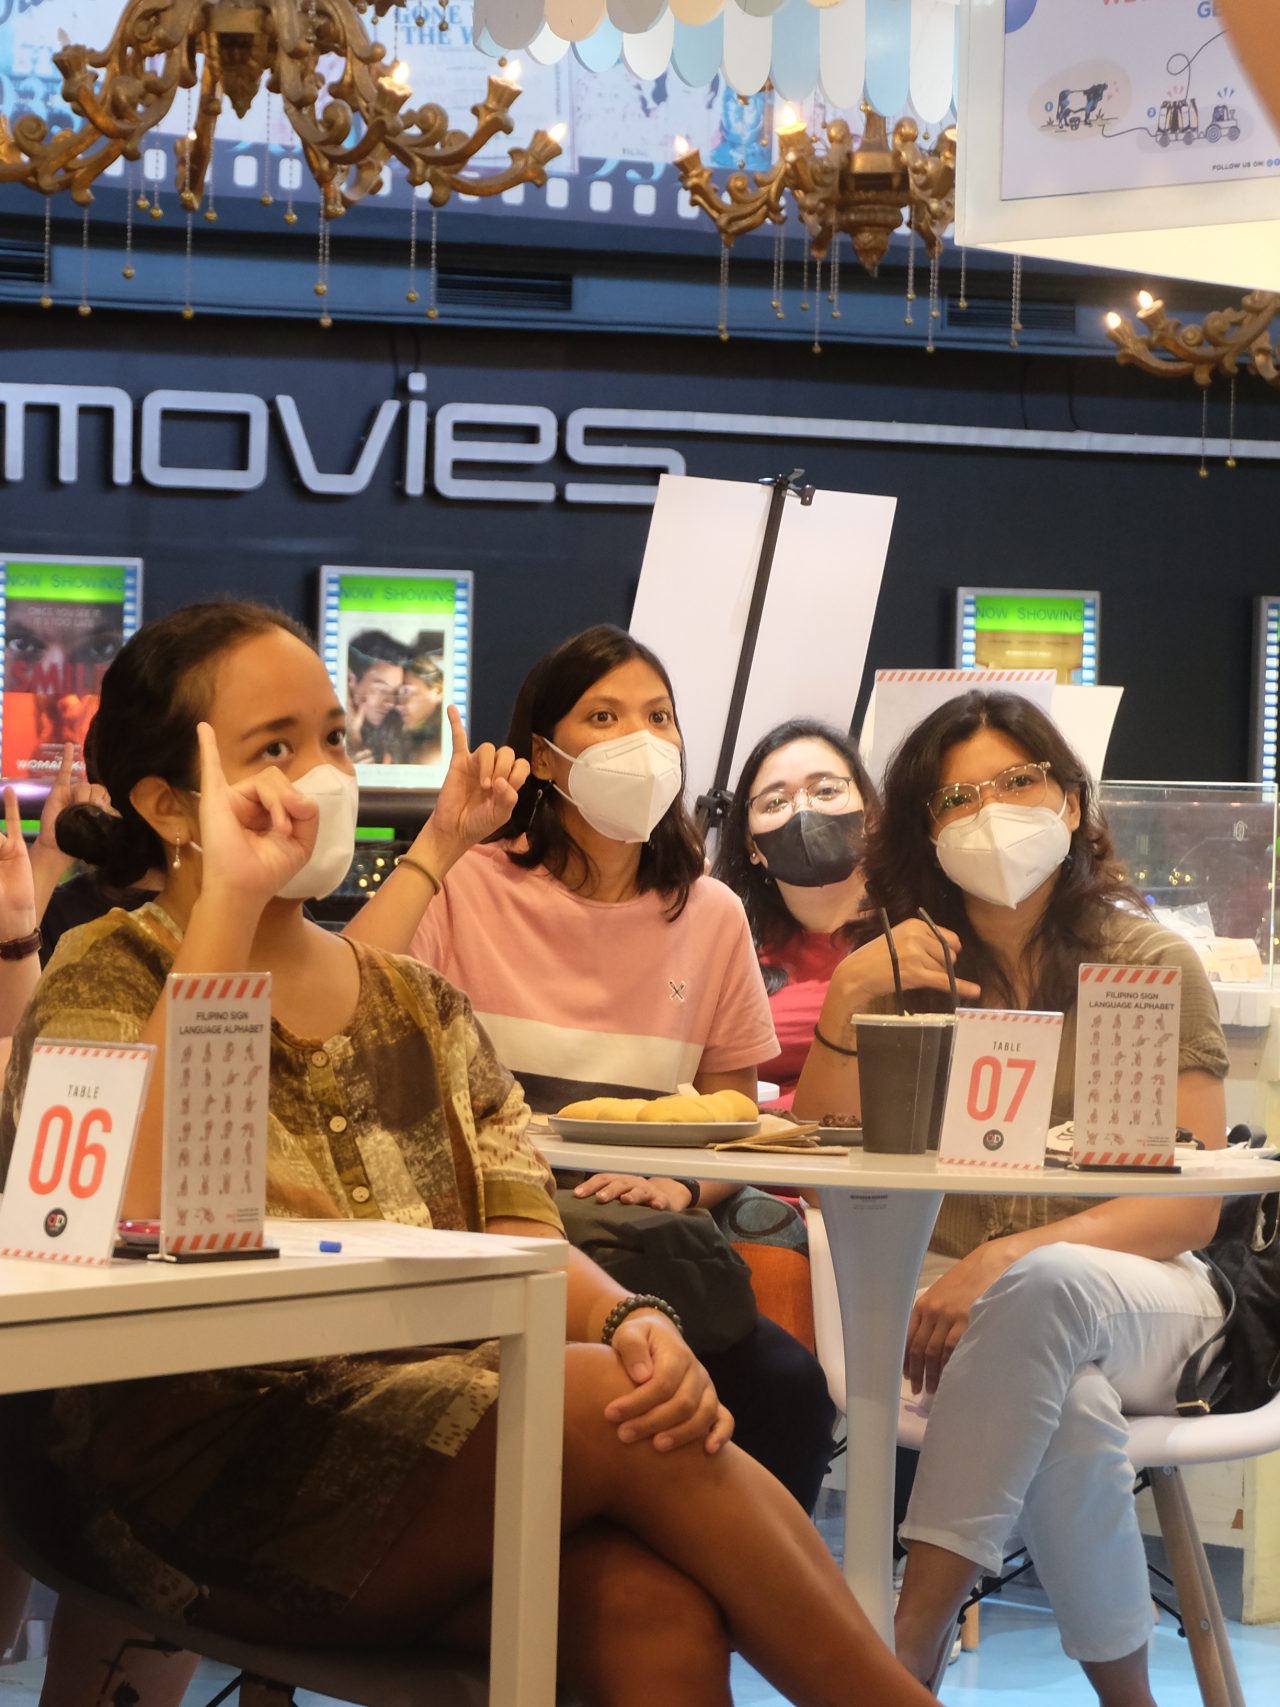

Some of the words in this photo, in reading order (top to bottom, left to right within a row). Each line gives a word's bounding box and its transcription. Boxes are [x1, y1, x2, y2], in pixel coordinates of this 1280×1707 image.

[396, 0, 462, 24] GONE
[404, 25, 451, 45] THE
[1212, 163, 1241, 171] FOLLOW
[383, 587, 455, 601] SHOWING
[976, 607, 1009, 619] NOW
[1017, 607, 1083, 621] SHOWING
[1105, 991, 1139, 1000] FILIPINO
[1140, 992, 1159, 1000] SIGN
[1089, 1001, 1132, 1009] LANGUAGE
[1134, 1002, 1175, 1010] ALPHABET
[196, 1011, 228, 1020] FILIPINO
[230, 1011, 249, 1020] SIGN
[179, 1025, 222, 1035] LANGUAGE
[223, 1023, 264, 1034] ALPHABET
[993, 1041, 1022, 1052] TABLE
[67, 1084, 100, 1099] TABLE
[966, 1055, 1037, 1123] 07
[28, 1104, 113, 1199] 06
